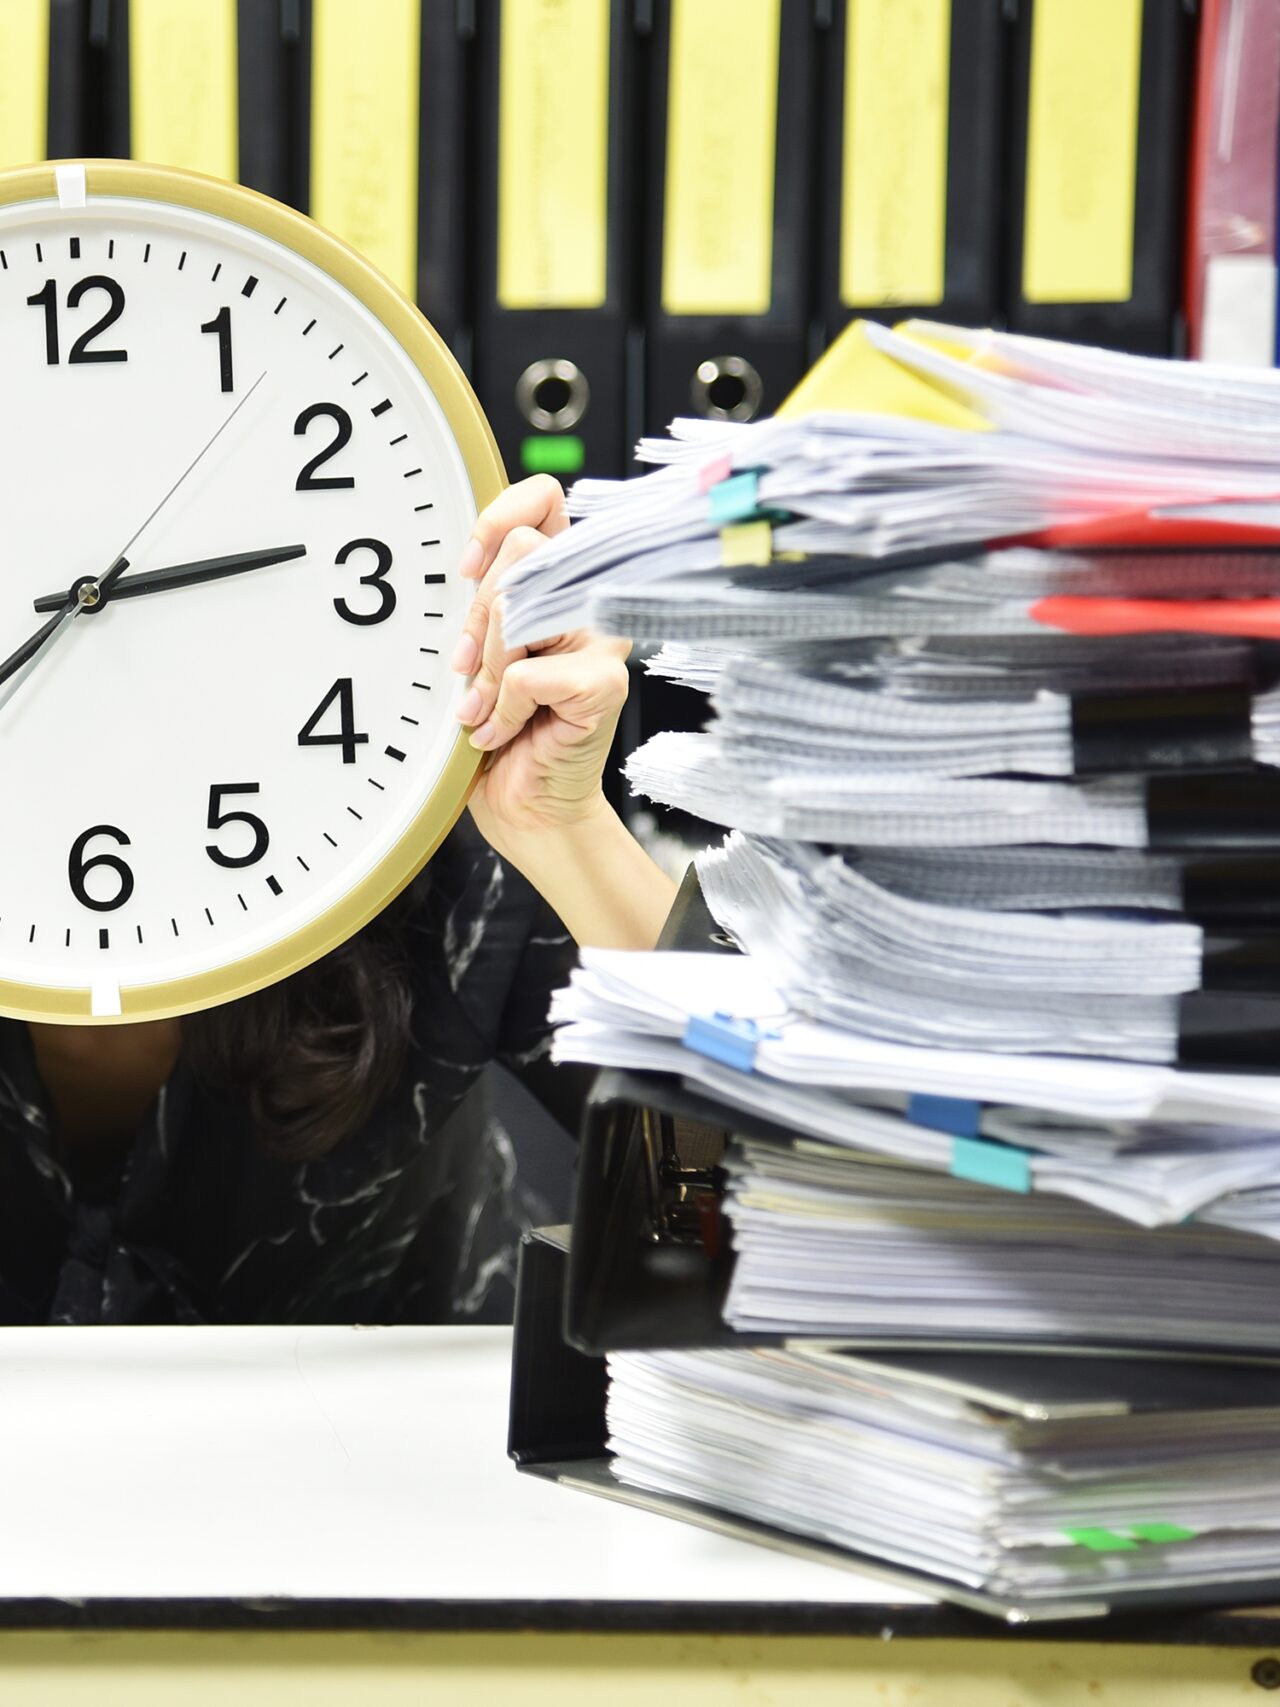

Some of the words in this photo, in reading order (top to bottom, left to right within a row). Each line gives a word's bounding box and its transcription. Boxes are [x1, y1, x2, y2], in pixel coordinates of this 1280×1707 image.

[27, 276, 128, 366] 12
[201, 307, 234, 393] 1
[294, 403, 355, 491] 2
[334, 539, 397, 626] 3
[298, 678, 369, 765] 4
[68, 825, 135, 912] 6
[206, 783, 270, 869] 5
